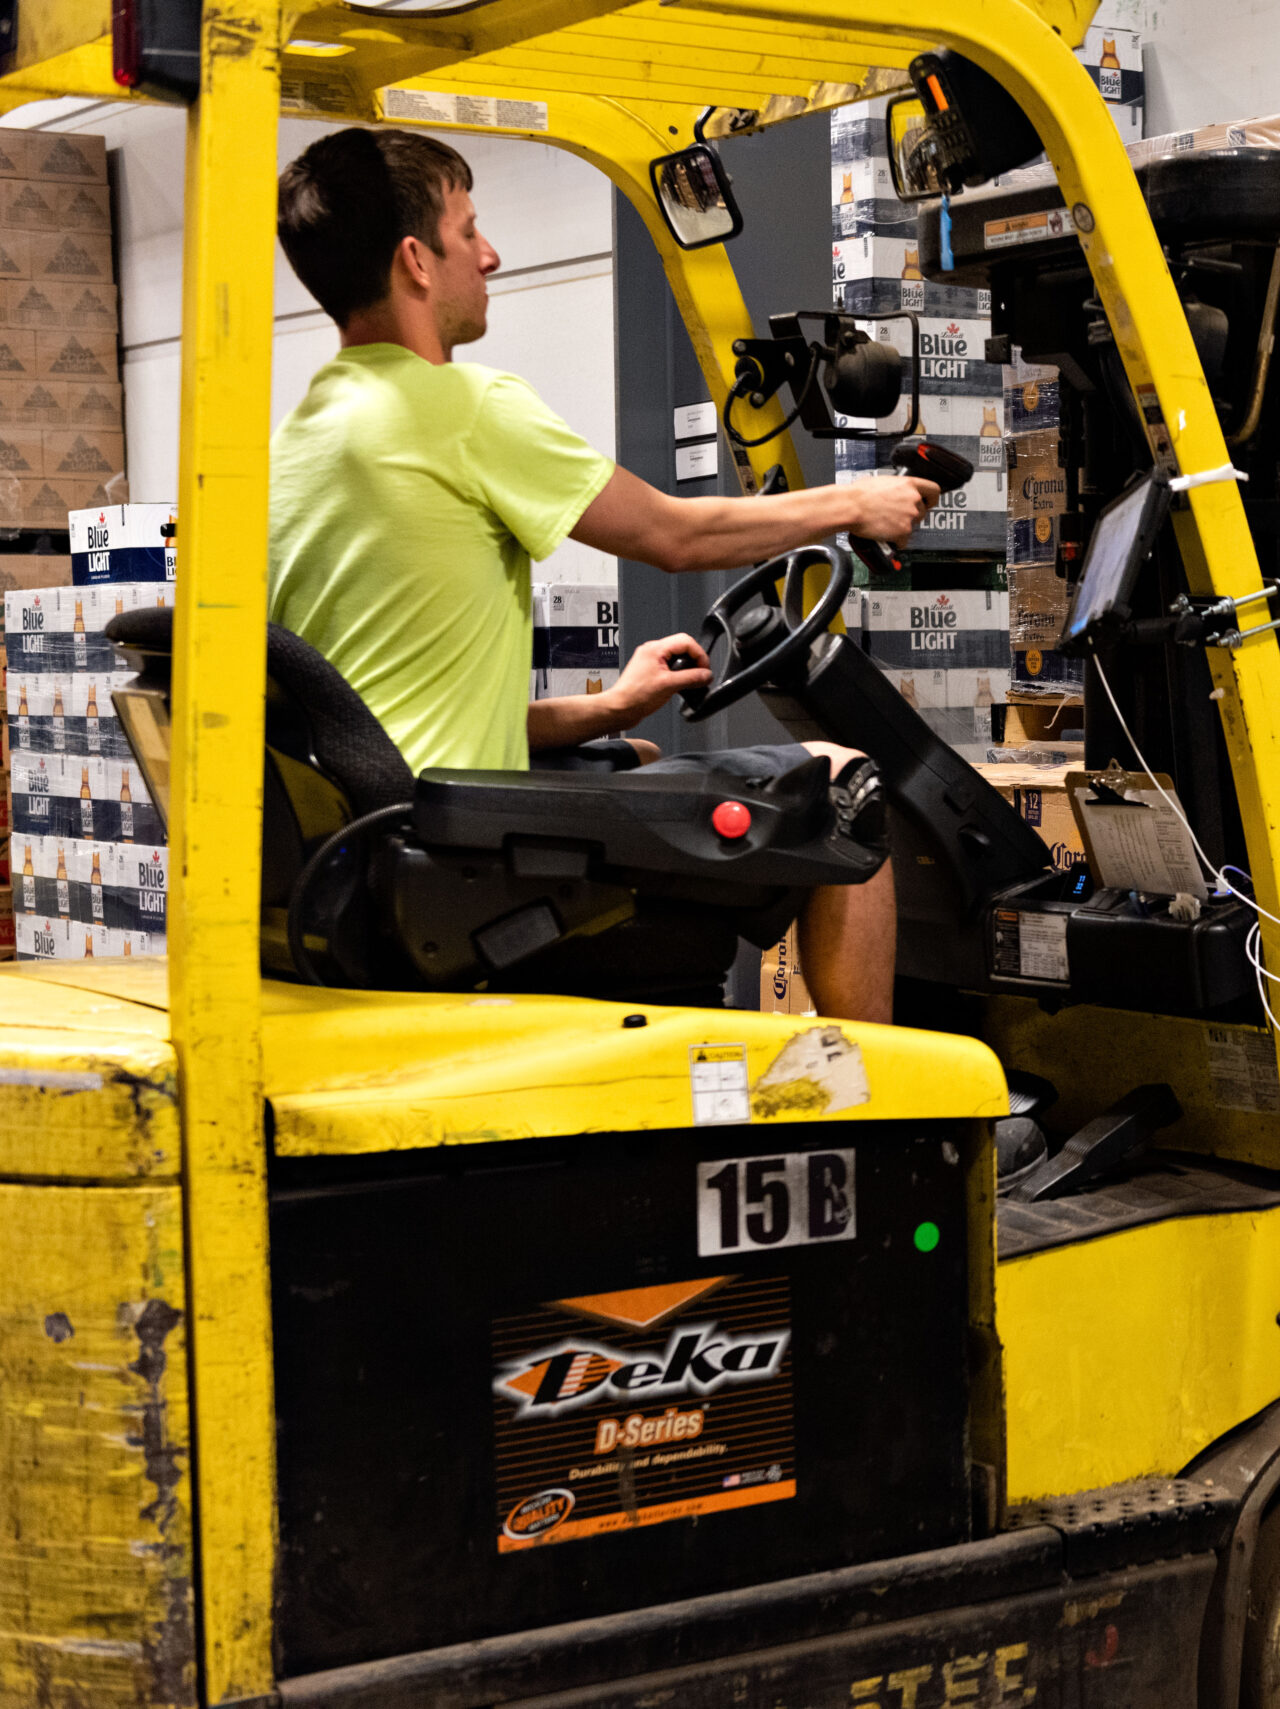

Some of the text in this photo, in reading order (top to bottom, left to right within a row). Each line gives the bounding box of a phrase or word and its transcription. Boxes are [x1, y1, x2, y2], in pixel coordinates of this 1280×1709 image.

[1100, 75, 1121, 87] Blue
[1100, 85, 1121, 96] LIGHT
[902, 287, 923, 299] Blue
[902, 298, 923, 308] LIGHT
[880, 327, 888, 336] 28
[920, 333, 967, 357] Blue
[920, 360, 967, 380] LIGHT
[1023, 475, 1065, 501] Corona
[1033, 497, 1053, 511] Extra
[920, 510, 966, 531] LIGHT
[88, 526, 109, 549] Blue
[88, 551, 110, 572] LIGHT
[553, 596, 562, 604] 28
[23, 608, 43, 630] Blue
[911, 605, 957, 629] Blue
[23, 634, 44, 654] LIGHT
[911, 631, 957, 651] LIGHT
[28, 770, 49, 792] Blue
[29, 796, 50, 815] LIGHT
[1028, 791, 1039, 810] 12
[139, 863, 164, 888] Blue
[139, 891, 165, 913] LIGHT
[34, 931, 55, 955] Blue
[493, 1321, 791, 1420] Deka
[595, 1408, 703, 1454] D-Series
